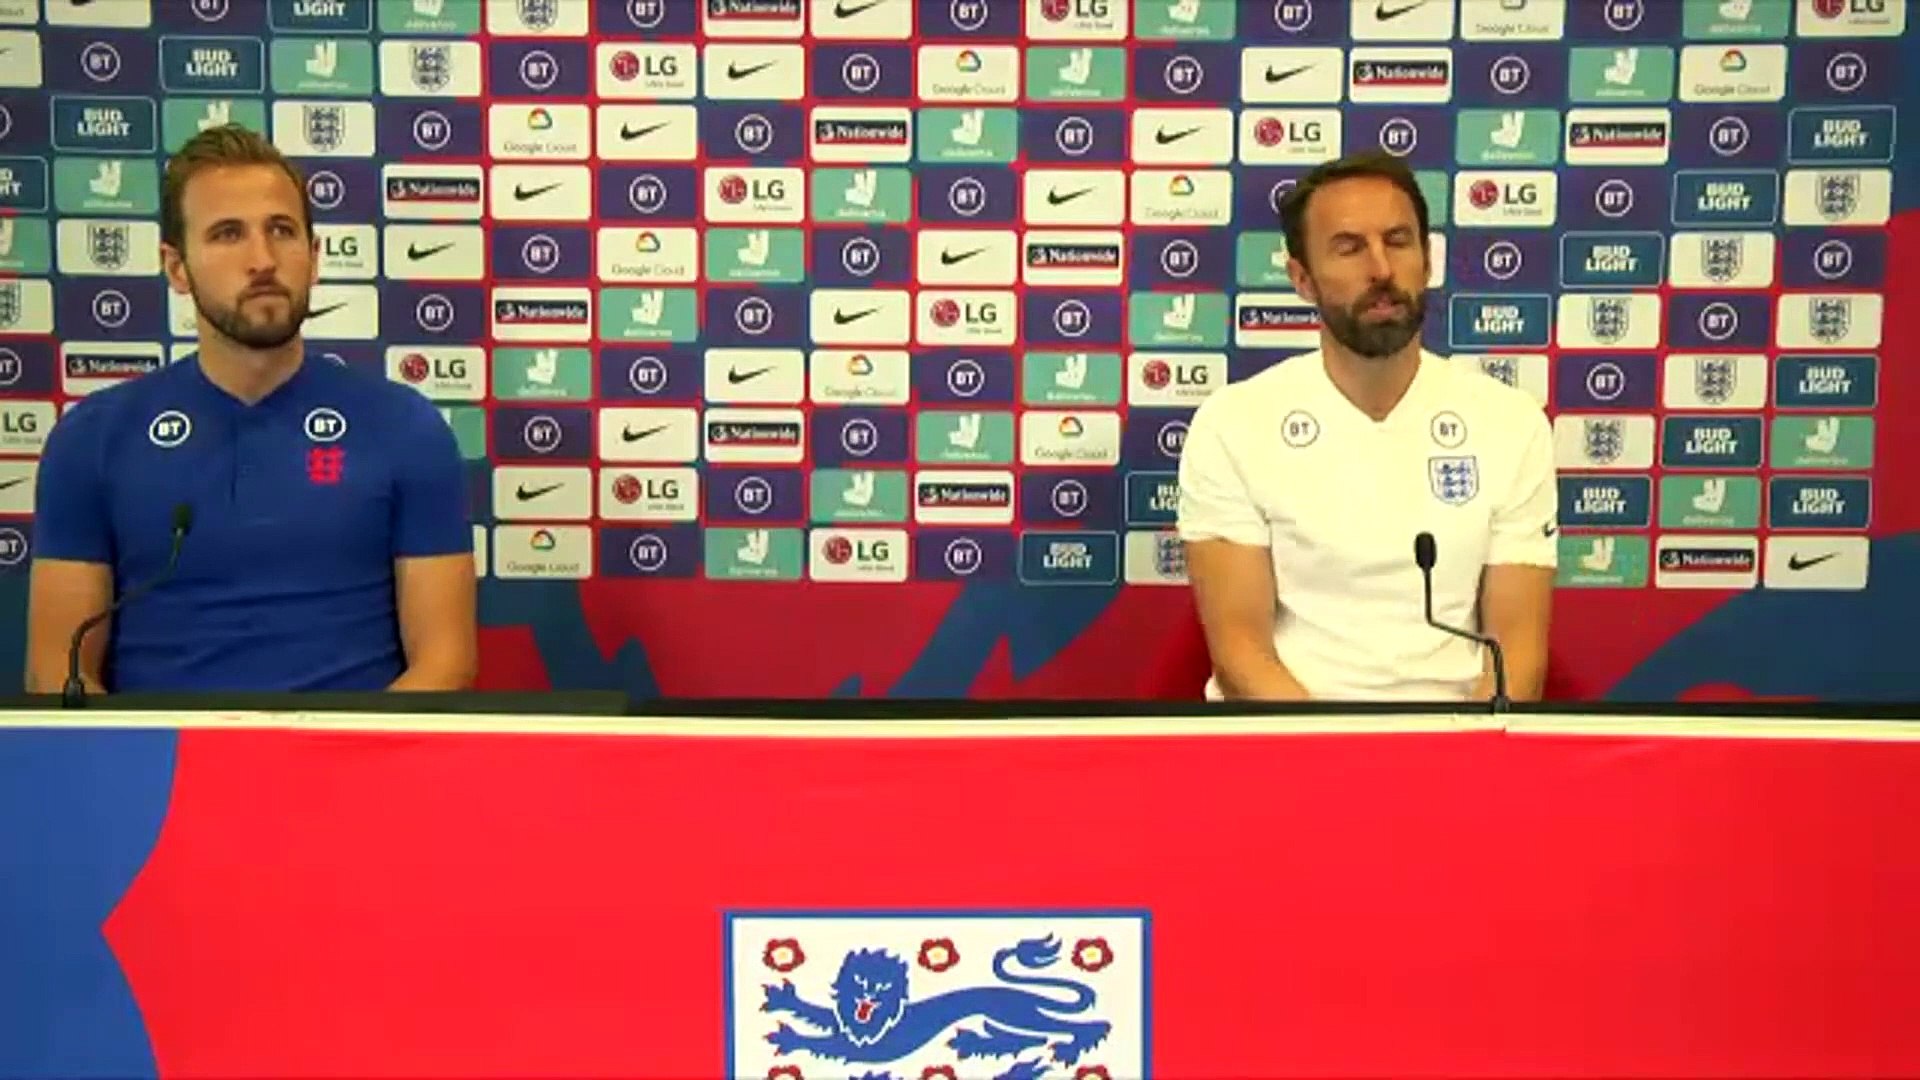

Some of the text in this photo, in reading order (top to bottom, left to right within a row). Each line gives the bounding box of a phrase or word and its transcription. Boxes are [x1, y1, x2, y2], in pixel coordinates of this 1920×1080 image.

[293, 1, 345, 16] LIGHT
[636, 2, 655, 15] BT
[960, 4, 977, 18] BT
[1076, 0, 1108, 18] LG
[1284, 6, 1302, 19] BT
[1614, 5, 1633, 18] BT
[1851, 0, 1885, 13] LG
[91, 55, 109, 68] BT
[193, 49, 231, 63] BUD
[186, 62, 237, 76] LIGHT
[529, 63, 548, 77] BT
[644, 56, 677, 76] LG
[852, 66, 870, 79] BT
[1836, 65, 1856, 78] BT
[1174, 68, 1193, 81] BT
[1500, 68, 1520, 81] BT
[83, 108, 122, 121] BUD
[77, 121, 130, 136] LIGHT
[423, 123, 440, 137] BT
[1289, 122, 1321, 142] LG
[1823, 119, 1861, 133] BUD
[744, 126, 763, 140] BT
[1065, 129, 1084, 143] BT
[1389, 130, 1407, 144] BT
[1719, 129, 1739, 143] BT
[1814, 132, 1867, 147] LIGHT
[315, 183, 334, 197] BT
[638, 187, 656, 200] BT
[752, 180, 785, 200] LG
[958, 189, 976, 203] BT
[1504, 184, 1537, 204] LG
[1706, 183, 1744, 196] BUD
[1605, 192, 1624, 205] BT
[1698, 196, 1752, 210] LIGHT
[326, 236, 357, 256] LG
[1592, 245, 1630, 258] BUD
[531, 247, 550, 260] BT
[852, 250, 869, 263] BT
[1170, 252, 1189, 265] BT
[1823, 252, 1842, 266] BT
[1493, 254, 1511, 267] BT
[1586, 258, 1638, 272] LIGHT
[102, 302, 120, 315] BT
[426, 306, 443, 319] BT
[965, 303, 997, 324] LG
[1481, 305, 1518, 319] BUD
[744, 309, 763, 322] BT
[1062, 312, 1082, 325] BT
[1708, 315, 1728, 327] BT
[1474, 319, 1524, 333] LIGHT
[434, 359, 466, 378] LG
[639, 369, 657, 381] BT
[1176, 365, 1207, 384] LG
[1807, 366, 1845, 380] BUD
[957, 372, 974, 384] BT
[1596, 375, 1615, 388] BT
[1799, 379, 1852, 394] LIGHT
[3, 411, 37, 432] LG
[315, 419, 336, 432] BT
[159, 422, 180, 435] BT
[534, 427, 550, 440] BT
[1290, 423, 1308, 436] BT
[1440, 423, 1456, 436] BT
[1694, 427, 1731, 441] BUD
[850, 430, 868, 443] BT
[1685, 440, 1737, 454] LIGHT
[647, 480, 679, 499] LG
[744, 489, 762, 501] BT
[1583, 487, 1620, 500] BUD
[1799, 488, 1838, 500] BUD
[1060, 492, 1078, 504] BT
[1574, 499, 1626, 514] LIGHT
[1793, 500, 1846, 514] LIGHT
[639, 546, 657, 559] BT
[857, 540, 889, 561] LG
[954, 550, 972, 562] BT
[1043, 555, 1092, 568] LIGHT
